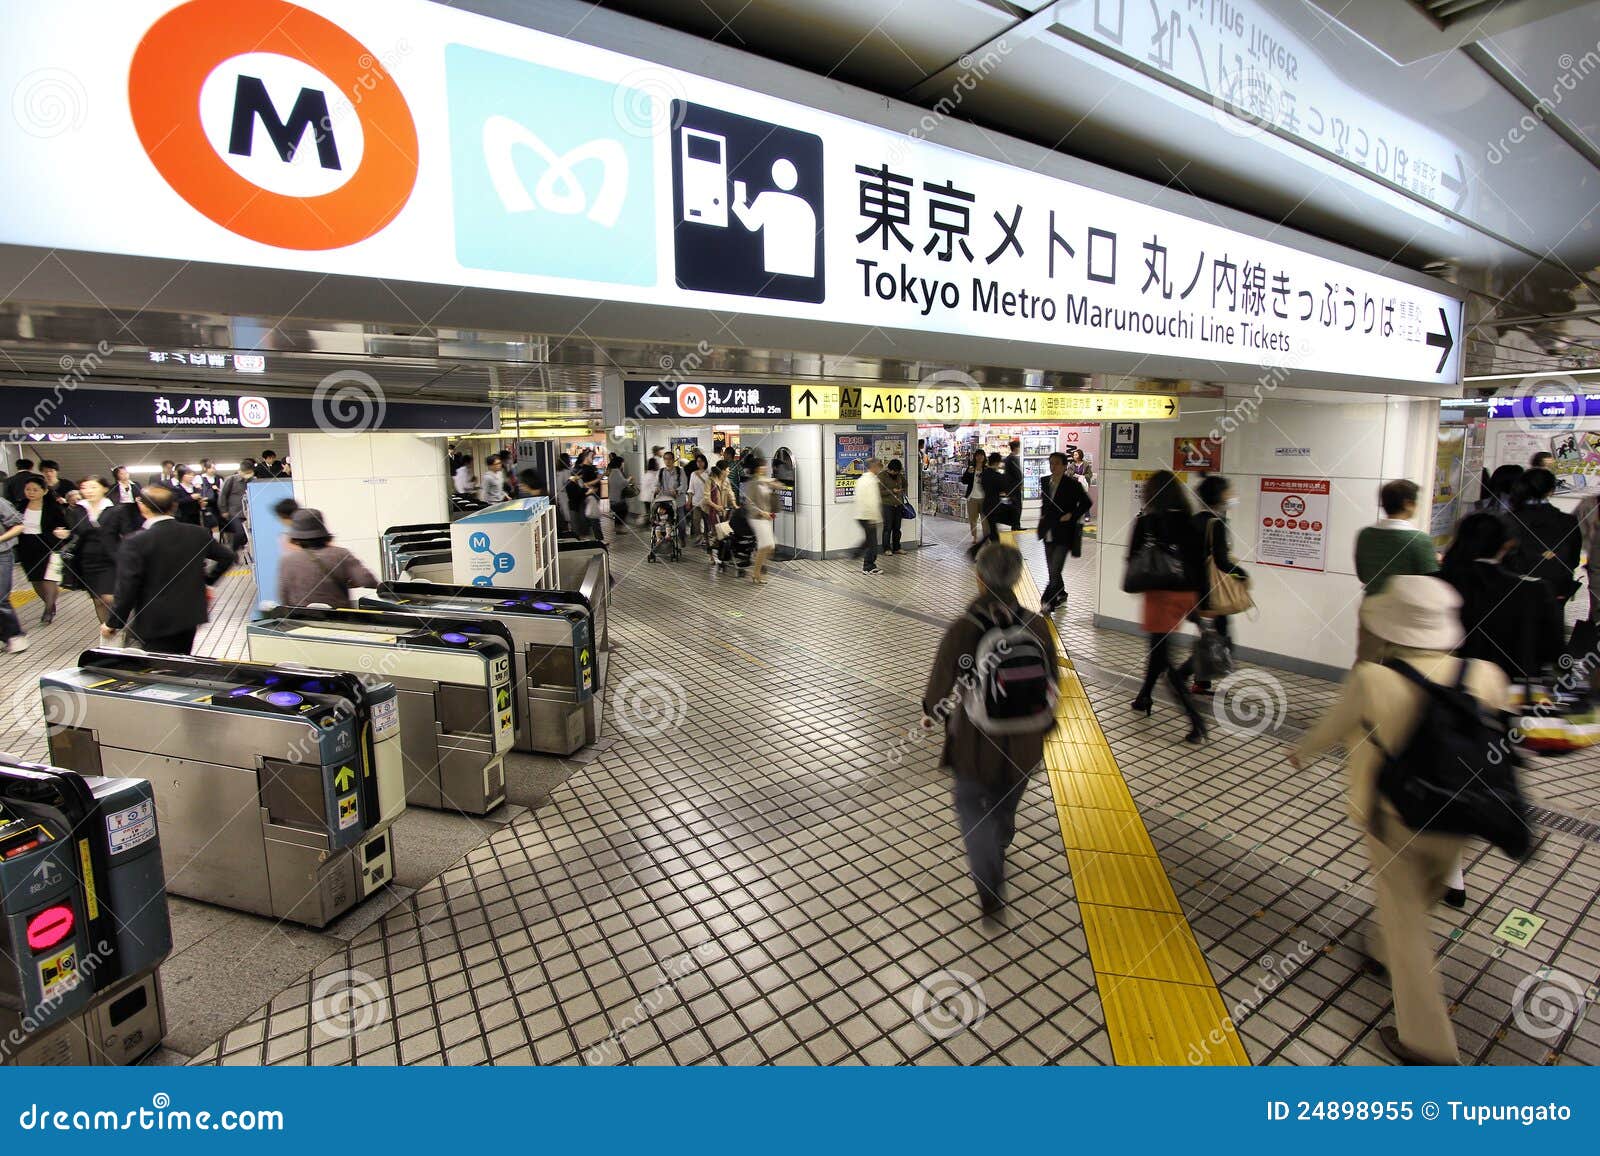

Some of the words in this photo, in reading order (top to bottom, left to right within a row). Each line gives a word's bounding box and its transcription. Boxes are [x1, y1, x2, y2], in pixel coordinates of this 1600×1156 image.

[228, 75, 342, 171] M
[855, 163, 1118, 285] 東京メトロ
[1141, 234, 1396, 339] 丸ノ内線きっぷうりば
[856, 259, 960, 315] Tokyo
[973, 277, 1057, 322] Metro
[1066, 294, 1195, 340] Marunouchi
[1200, 315, 1235, 345] Line
[1240, 321, 1291, 353] Tickets
[687, 395, 697, 405] M
[707, 387, 760, 405] 丸ノ内線
[840, 388, 861, 408] A7
[154, 397, 231, 416] 丸ノ内線
[708, 405, 749, 414] Marunouchi
[751, 405, 765, 414] Line
[767, 406, 781, 414] 25m
[156, 415, 217, 425] Marunouchi
[219, 415, 239, 425] Line
[473, 537, 486, 548] M
[499, 557, 509, 569] E
[495, 659, 508, 672] IC
